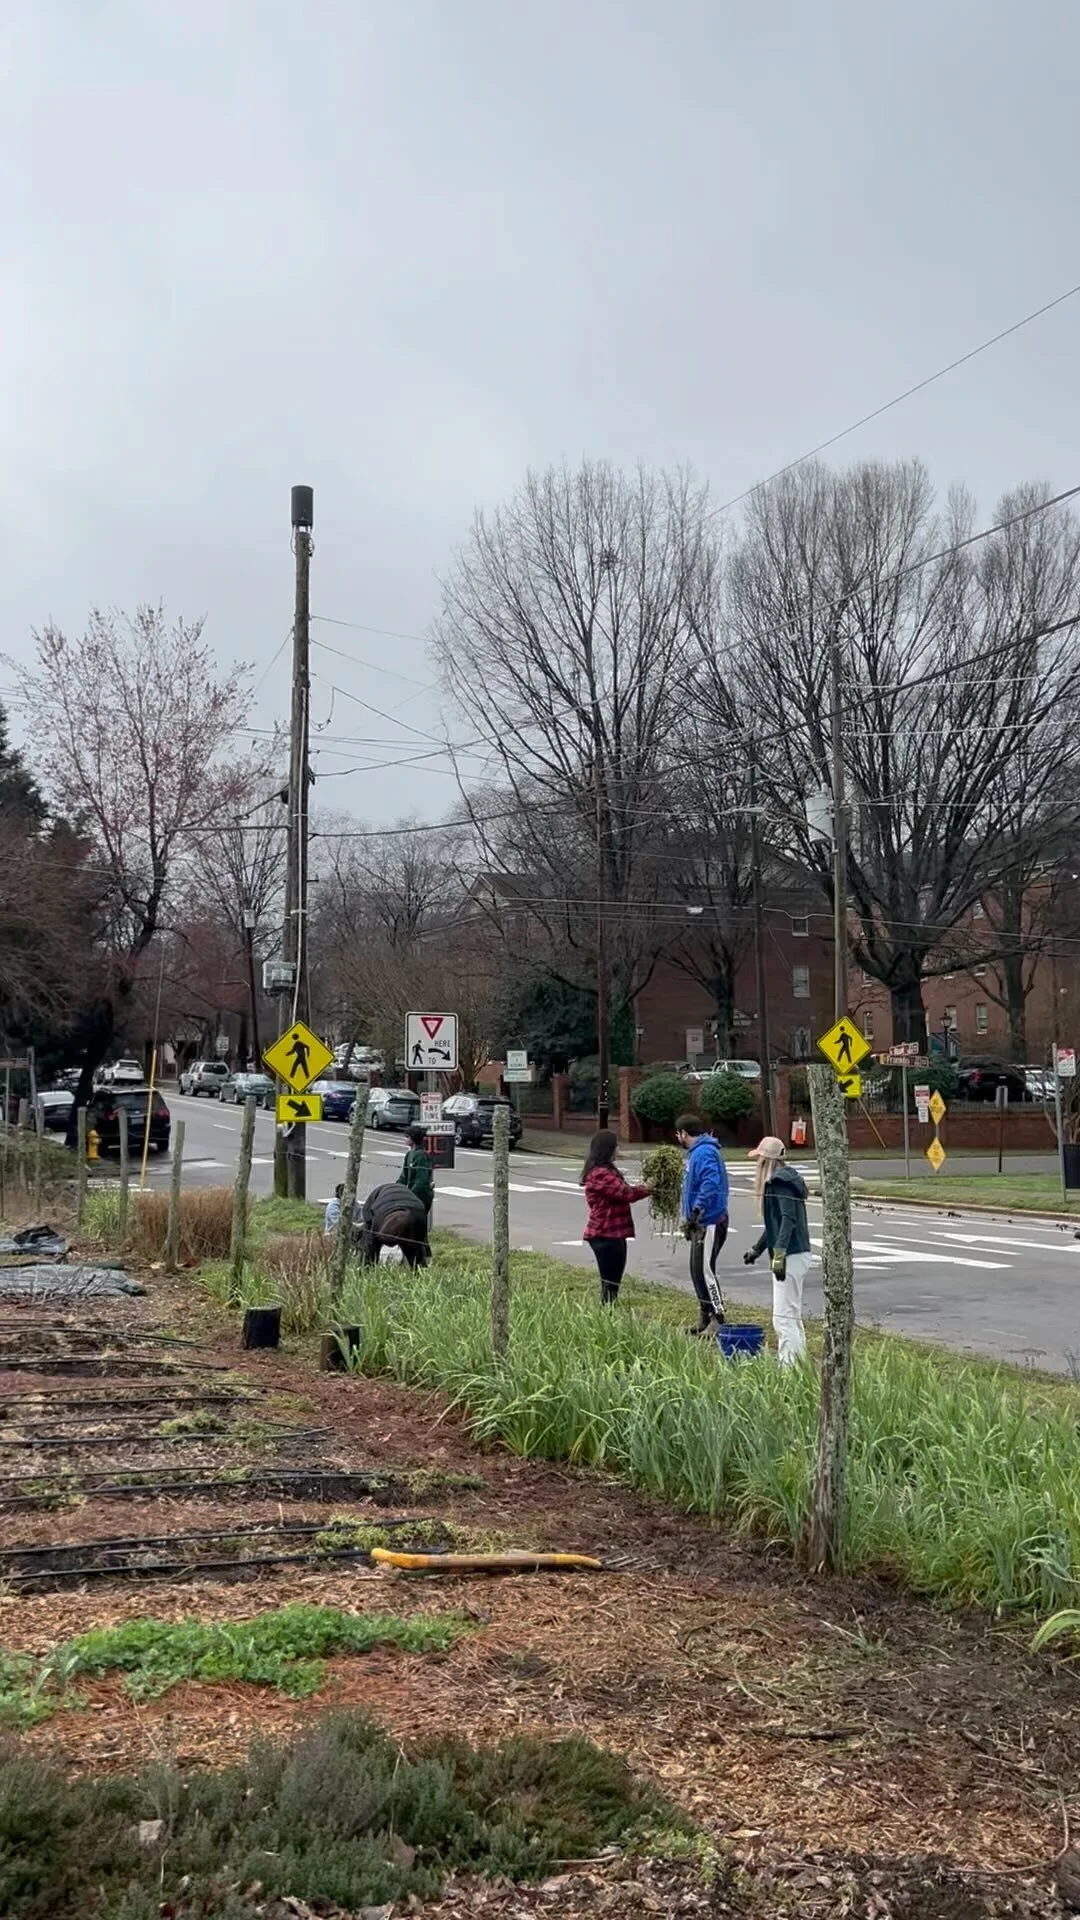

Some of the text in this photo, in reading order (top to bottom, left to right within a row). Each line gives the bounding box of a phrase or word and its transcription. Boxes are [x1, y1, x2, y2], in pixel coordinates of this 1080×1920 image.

[434, 1039, 451, 1048] HERE
[428, 1057, 437, 1065] TO
[433, 1123, 454, 1132] SPEED
